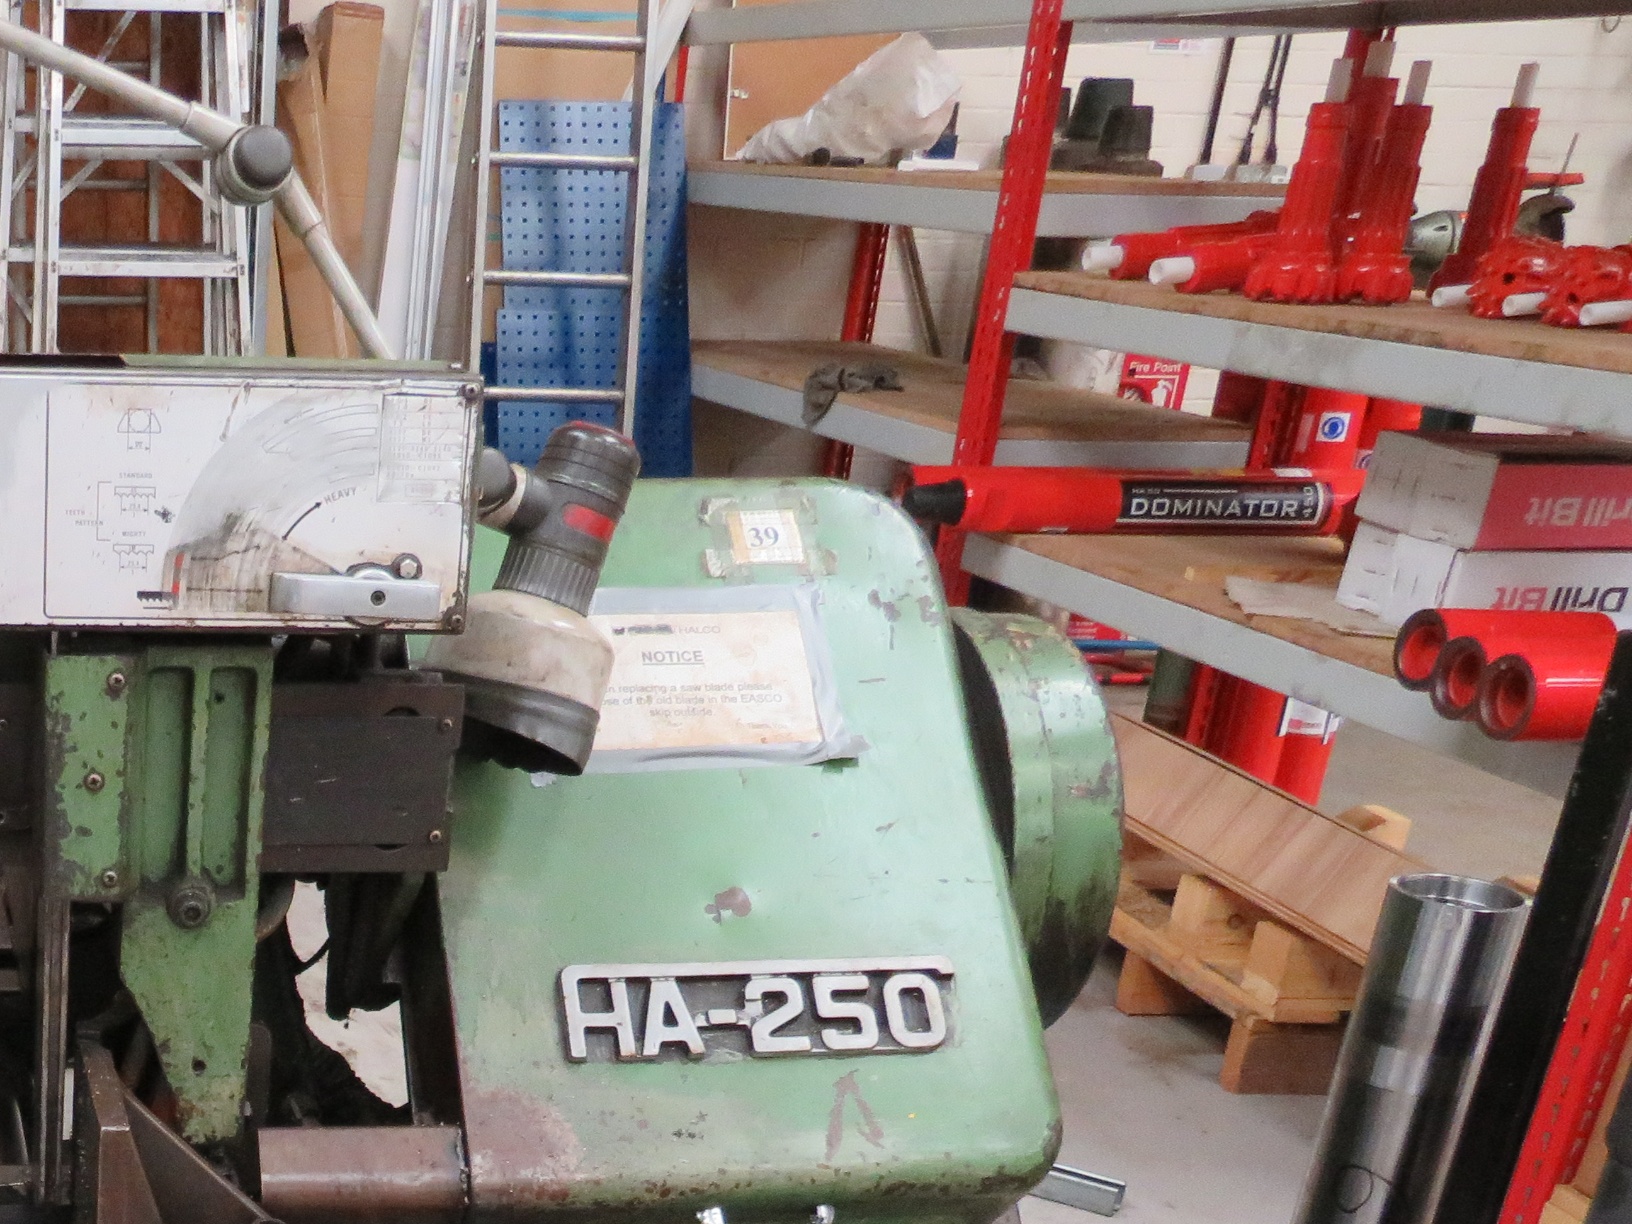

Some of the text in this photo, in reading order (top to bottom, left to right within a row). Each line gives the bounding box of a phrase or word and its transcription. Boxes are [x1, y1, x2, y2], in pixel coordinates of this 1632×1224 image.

[1129, 361, 1182, 373] Fire Point
[323, 487, 357, 505] HEAVY
[1130, 498, 1299, 518] DOMINATOR
[747, 526, 780, 548] 39
[678, 625, 721, 635] HALCO
[641, 650, 704, 664] NOTICE
[618, 682, 667, 696] replacing
[680, 684, 702, 692] saw
[704, 682, 734, 692] blade
[737, 682, 774, 694] please
[622, 696, 633, 706] of
[655, 696, 674, 705] old
[675, 695, 705, 705] blade
[707, 695, 718, 704] in
[720, 694, 738, 704] the
[741, 693, 782, 704] EASCO
[649, 708, 671, 718] skip
[563, 970, 950, 1062] HA-250
